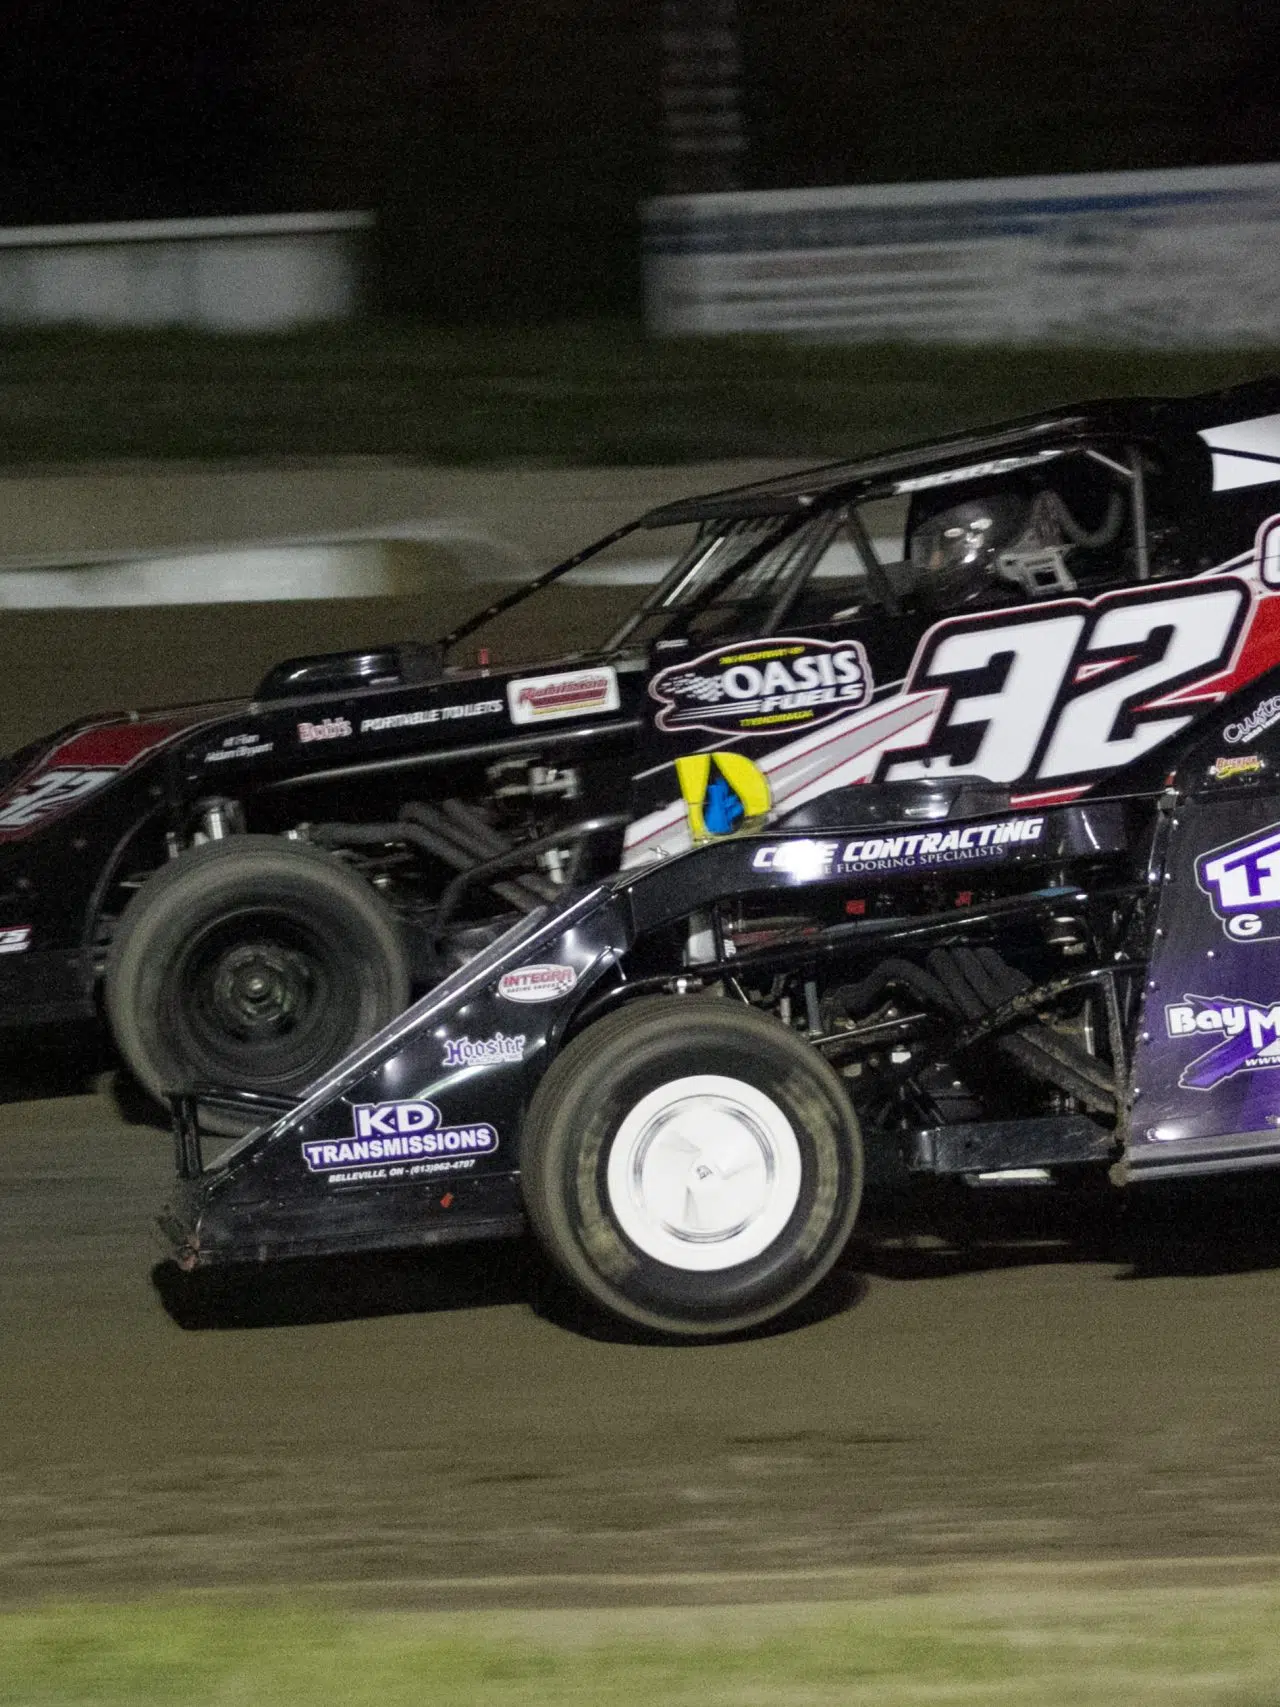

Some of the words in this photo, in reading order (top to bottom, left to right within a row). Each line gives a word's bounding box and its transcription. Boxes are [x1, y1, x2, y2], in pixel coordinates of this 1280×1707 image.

[723, 650, 862, 699] OASIS
[886, 590, 1242, 783] 32
[760, 684, 864, 713] FUELS
[842, 818, 1044, 863] CONTRACTING
[836, 856, 916, 874] FLOORING
[919, 844, 1003, 865] SPECIALISTS
[503, 968, 573, 987] INTEGRA
[1168, 1005, 1245, 1034] Bay
[443, 1032, 525, 1066] Hoosier
[358, 1104, 435, 1137] KD
[308, 1128, 491, 1164] TRANSMISSIONS
[328, 1170, 387, 1184] BELLEVILLE,
[390, 1167, 404, 1177] ON
